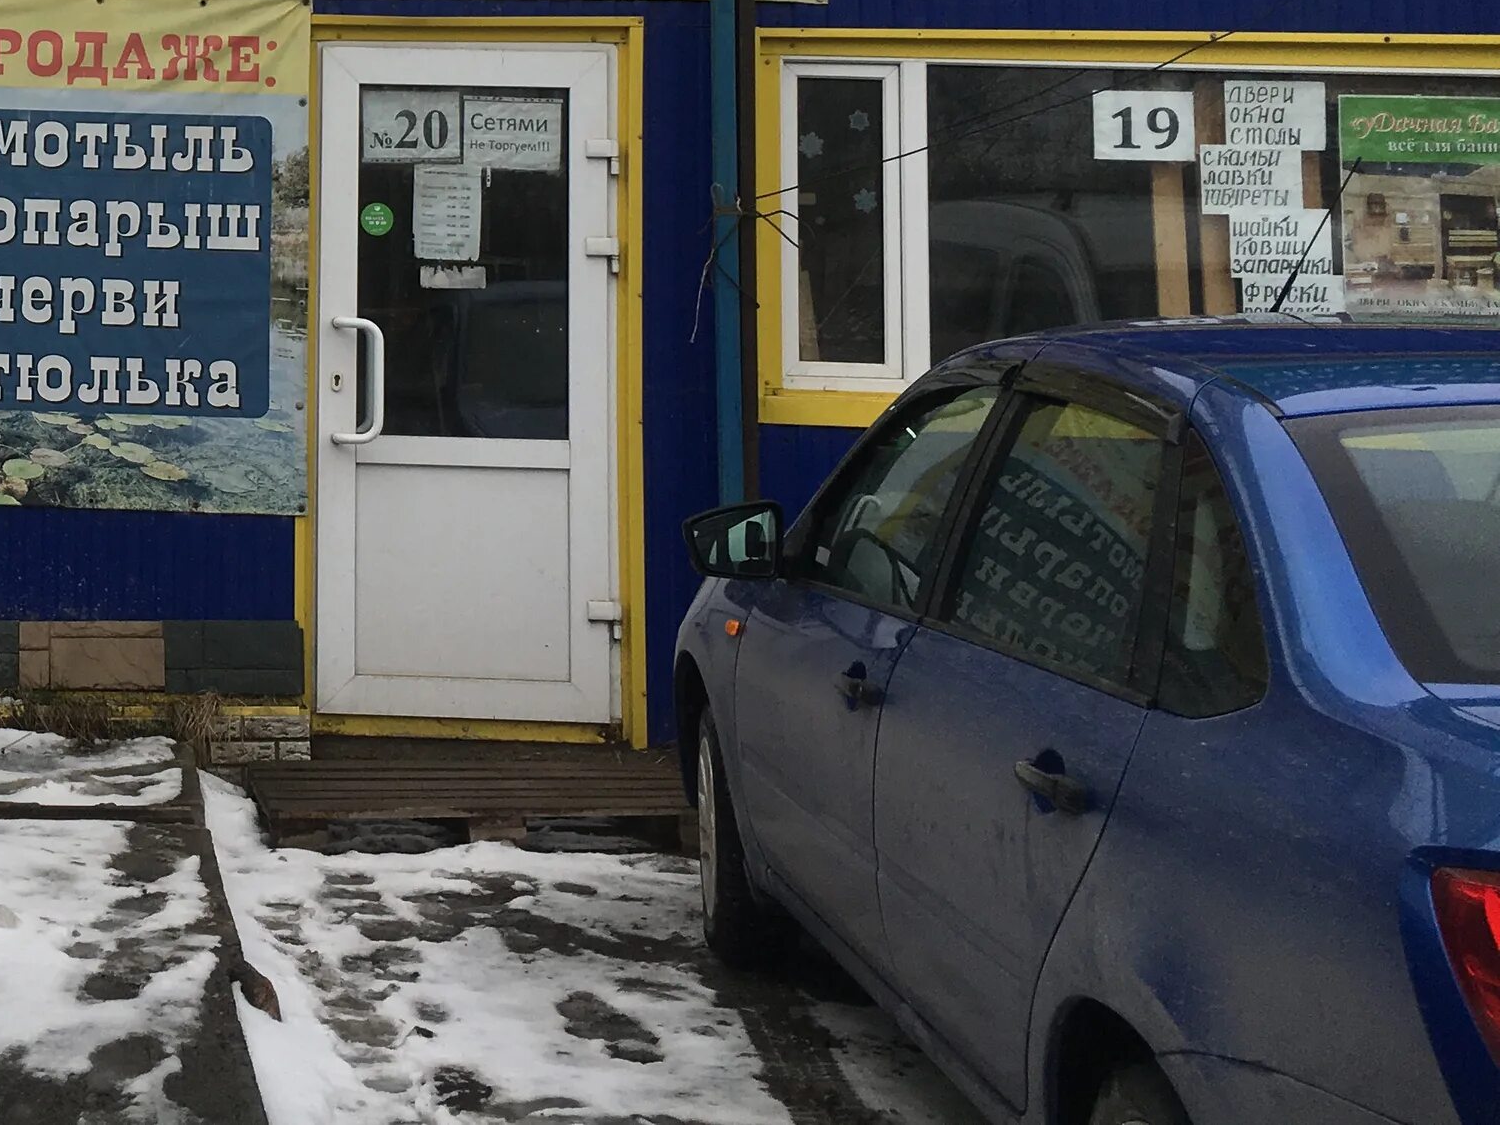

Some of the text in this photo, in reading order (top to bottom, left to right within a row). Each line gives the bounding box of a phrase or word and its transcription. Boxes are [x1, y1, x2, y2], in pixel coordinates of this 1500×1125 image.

[470, 112, 549, 132] Сетями
[1229, 105, 1285, 124] окна
[1111, 106, 1180, 150] 19
[1230, 126, 1302, 146] столы
[469, 139, 486, 150] Не
[1387, 137, 1416, 153] всё
[1203, 168, 1273, 186] лавки
[1232, 215, 1299, 237] шайки
